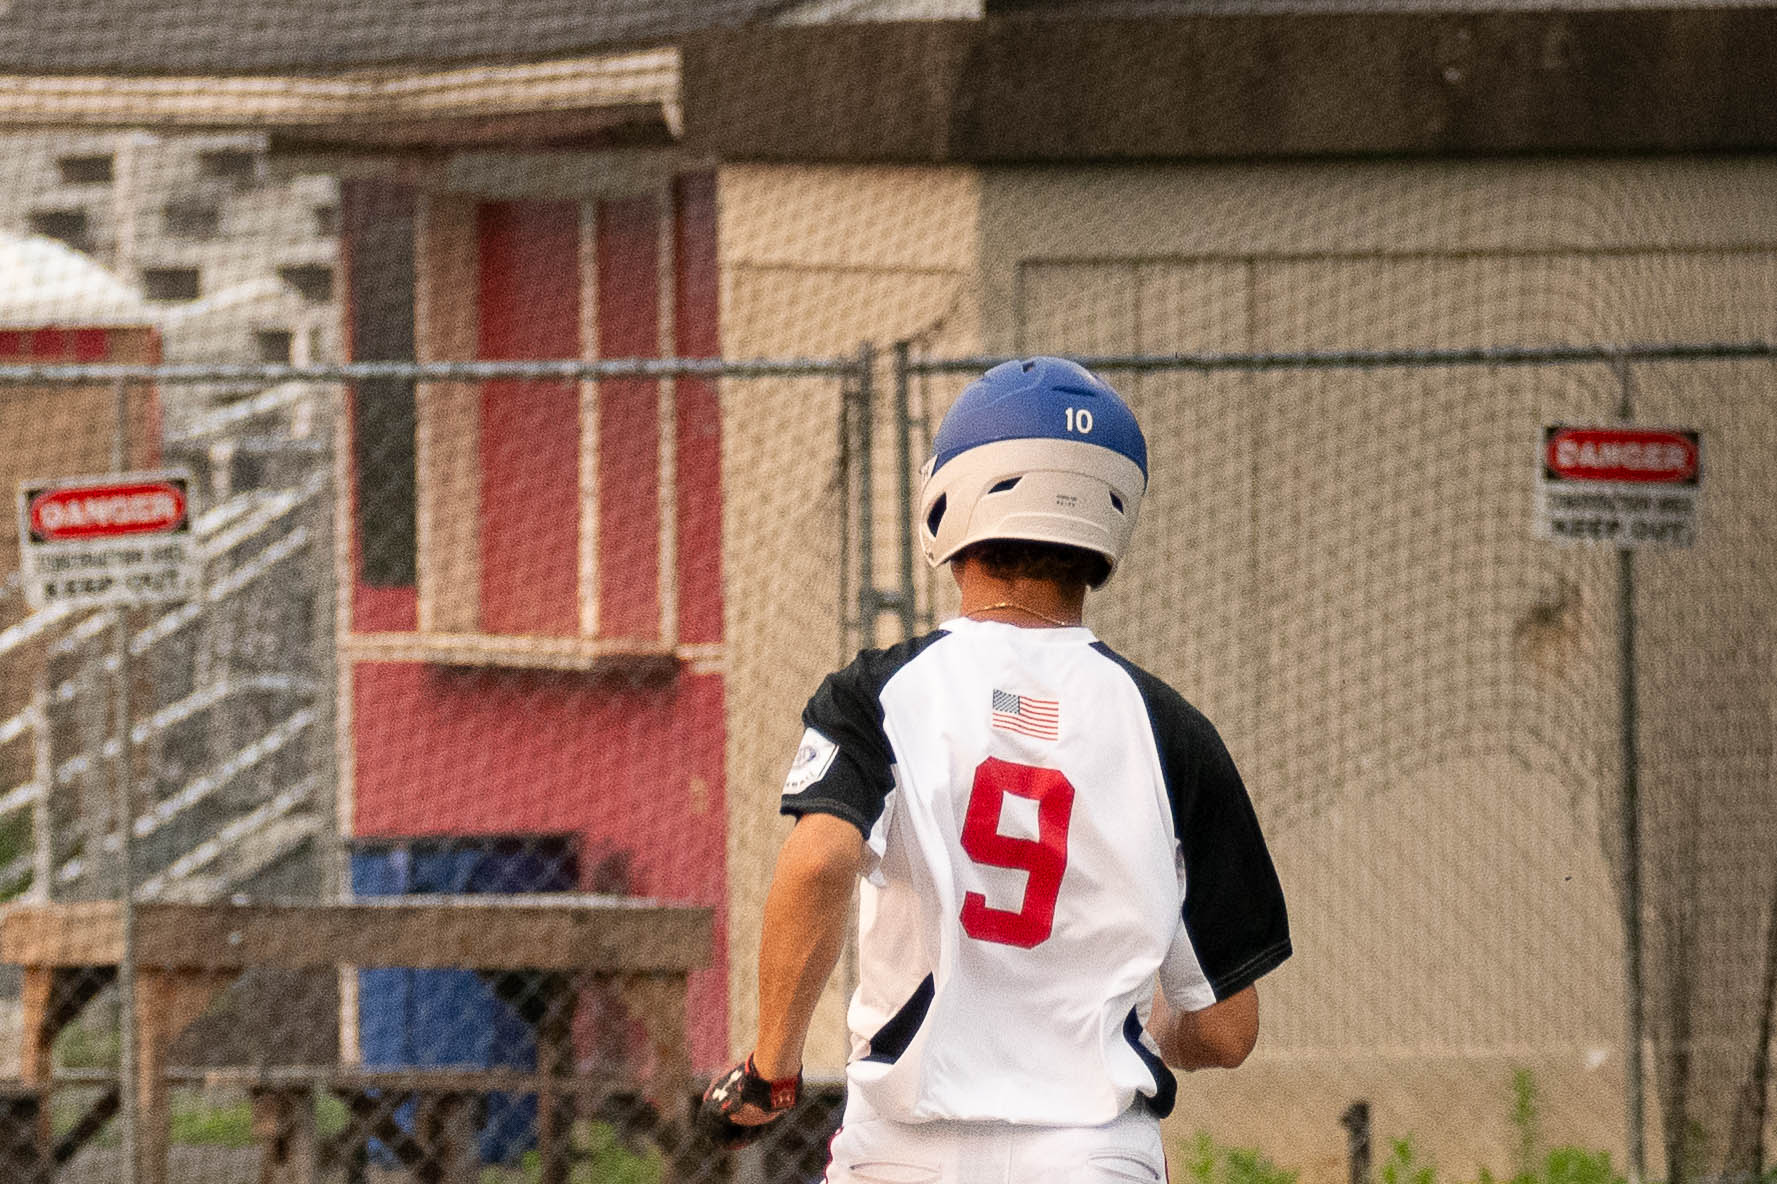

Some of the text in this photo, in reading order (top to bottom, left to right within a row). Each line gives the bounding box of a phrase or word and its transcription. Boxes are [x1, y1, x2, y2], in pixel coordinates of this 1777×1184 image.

[1065, 407, 1094, 434] 10
[1556, 439, 1685, 471] DANGER
[39, 492, 176, 530] DANGER
[959, 756, 1075, 949] 9
